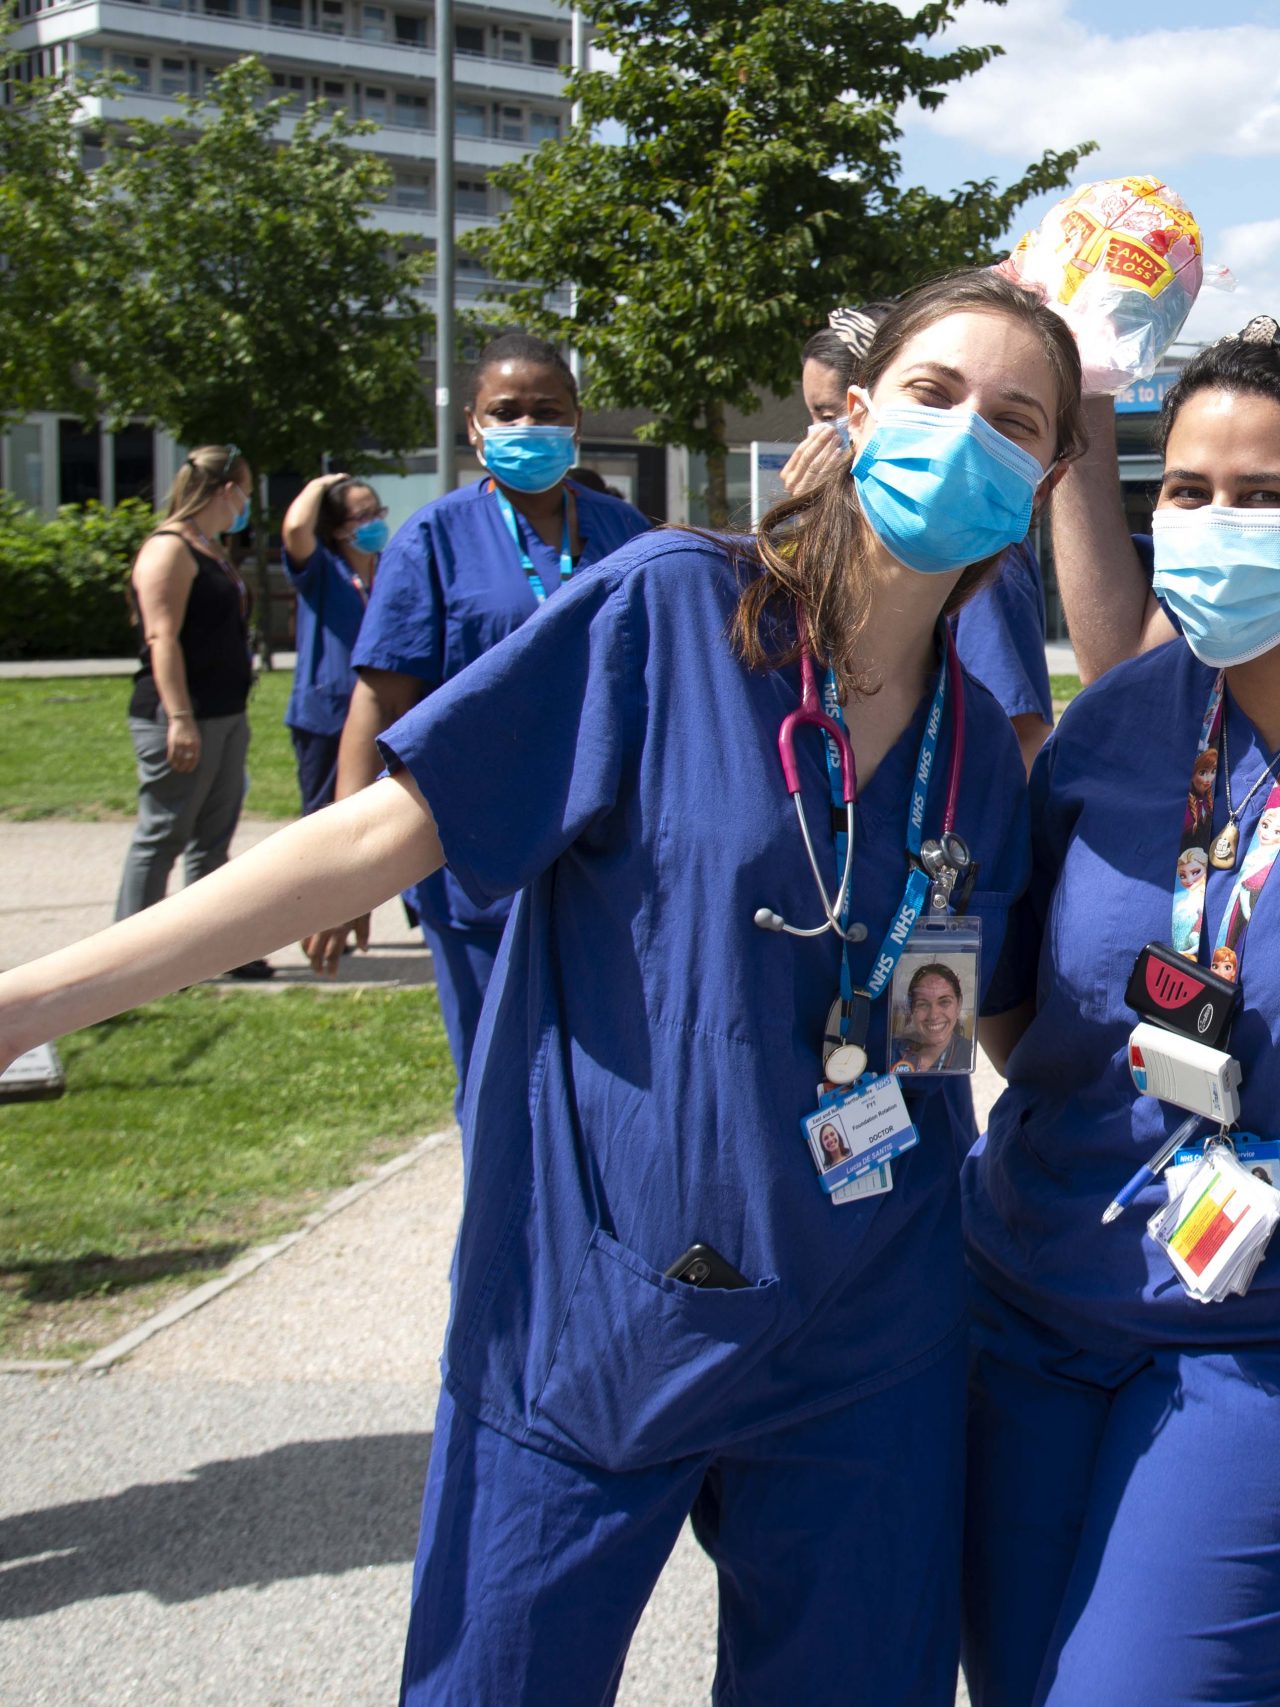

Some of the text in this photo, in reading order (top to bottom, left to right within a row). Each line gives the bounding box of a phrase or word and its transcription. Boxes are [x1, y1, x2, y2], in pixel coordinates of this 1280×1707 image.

[1106, 257, 1152, 281] FLOSS
[1107, 243, 1162, 276] CANDY
[824, 682, 841, 719] NHS
[927, 703, 941, 740] NHS
[917, 747, 932, 784] NHS
[911, 791, 924, 829] NHS
[890, 904, 916, 946] NHS
[868, 952, 894, 992] NHS
[852, 1103, 898, 1131] Foundation Rotation
[868, 1125, 894, 1144] DOCTOR
[846, 1142, 894, 1174] Lucia DE SANTIS
[1180, 1154, 1193, 1162] NHS
